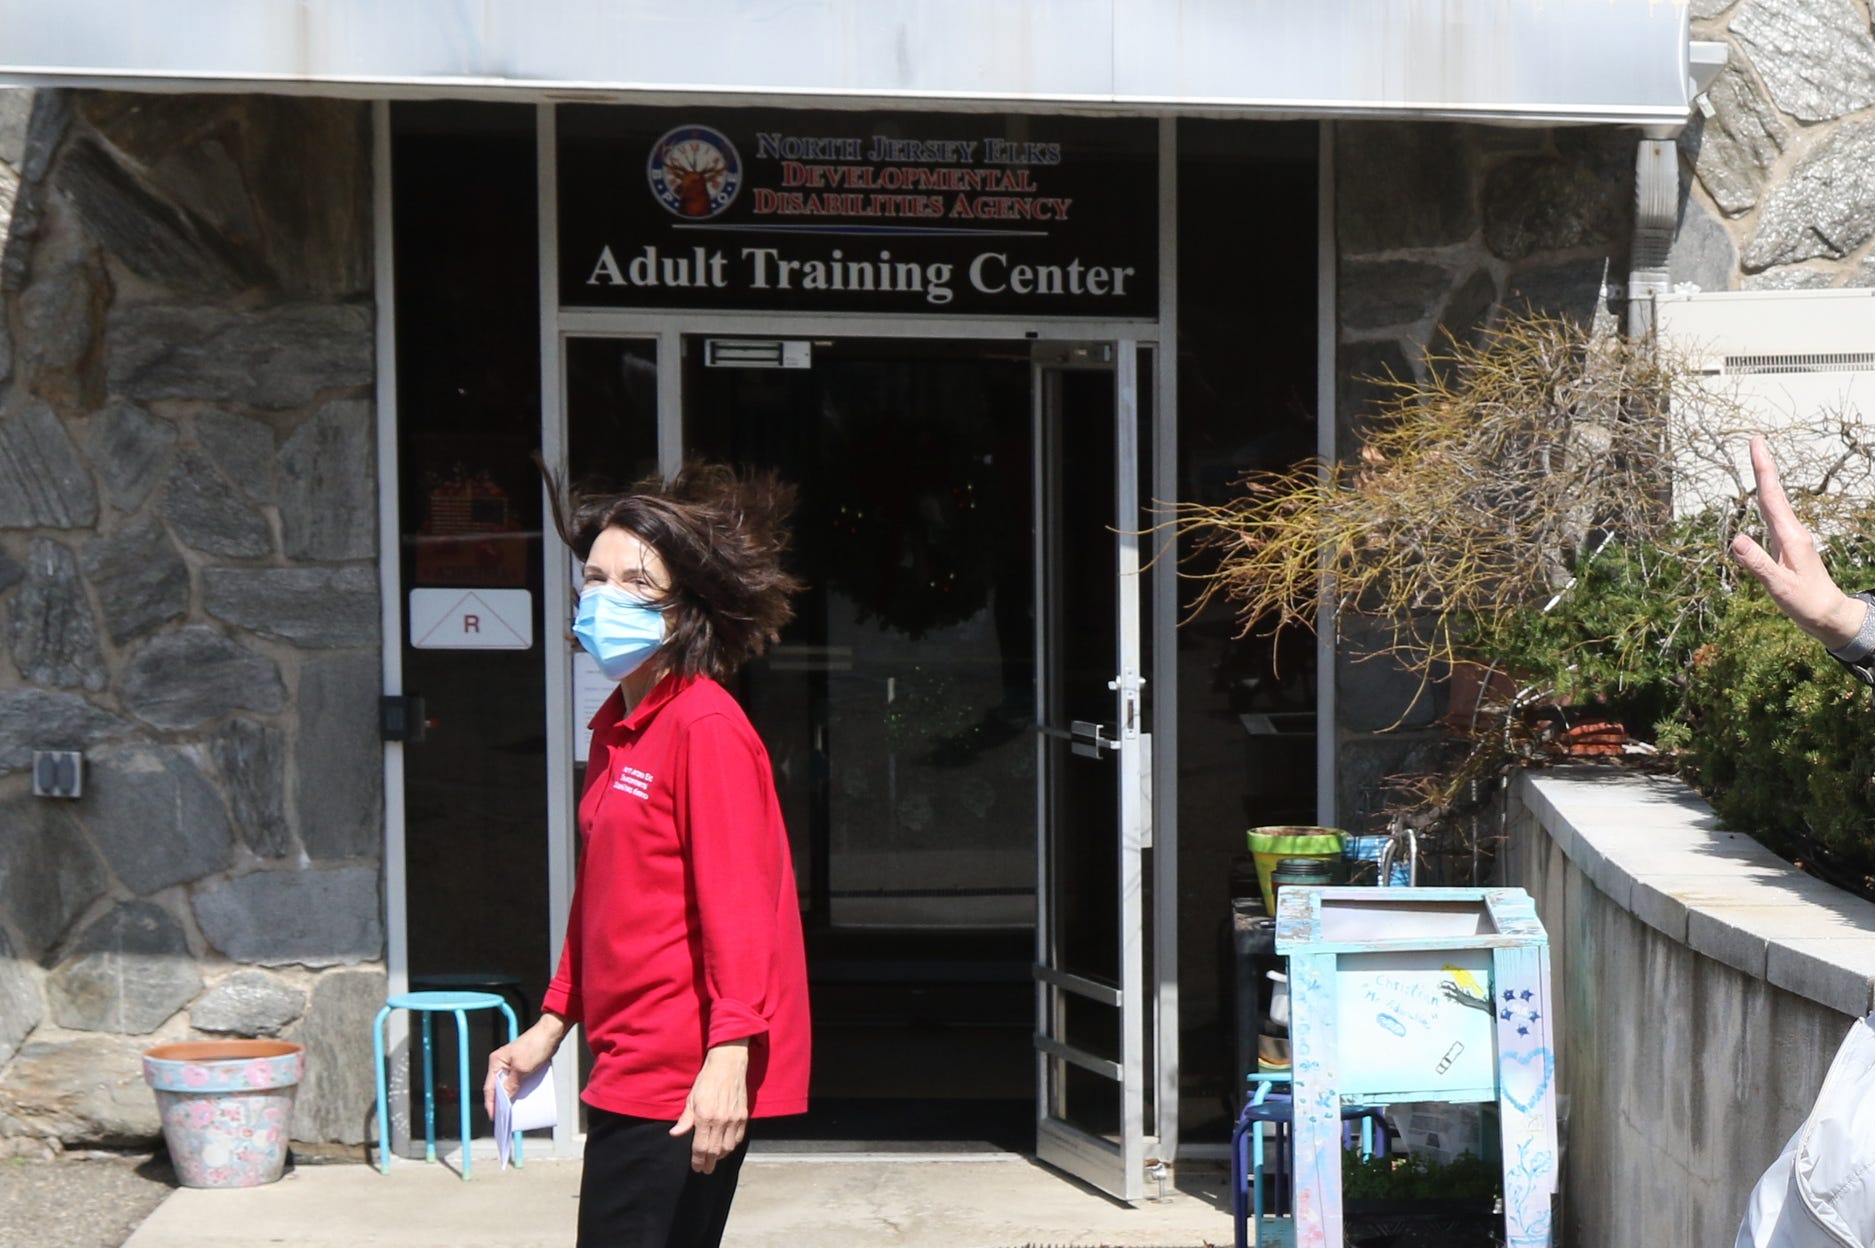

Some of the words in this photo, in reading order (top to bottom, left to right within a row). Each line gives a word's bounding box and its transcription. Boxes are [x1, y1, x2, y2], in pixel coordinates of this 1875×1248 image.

[756, 133, 862, 161] NORTH
[867, 135, 977, 163] JERSEY
[984, 138, 1062, 165] ELKS
[781, 161, 1037, 192] DEVELOPMENTAL
[753, 188, 944, 217] DISABILITIES
[949, 193, 1073, 220] AGENCY
[586, 244, 729, 289] Adult
[741, 247, 954, 304] Training
[968, 252, 1136, 297] Center
[463, 614, 481, 634] R
